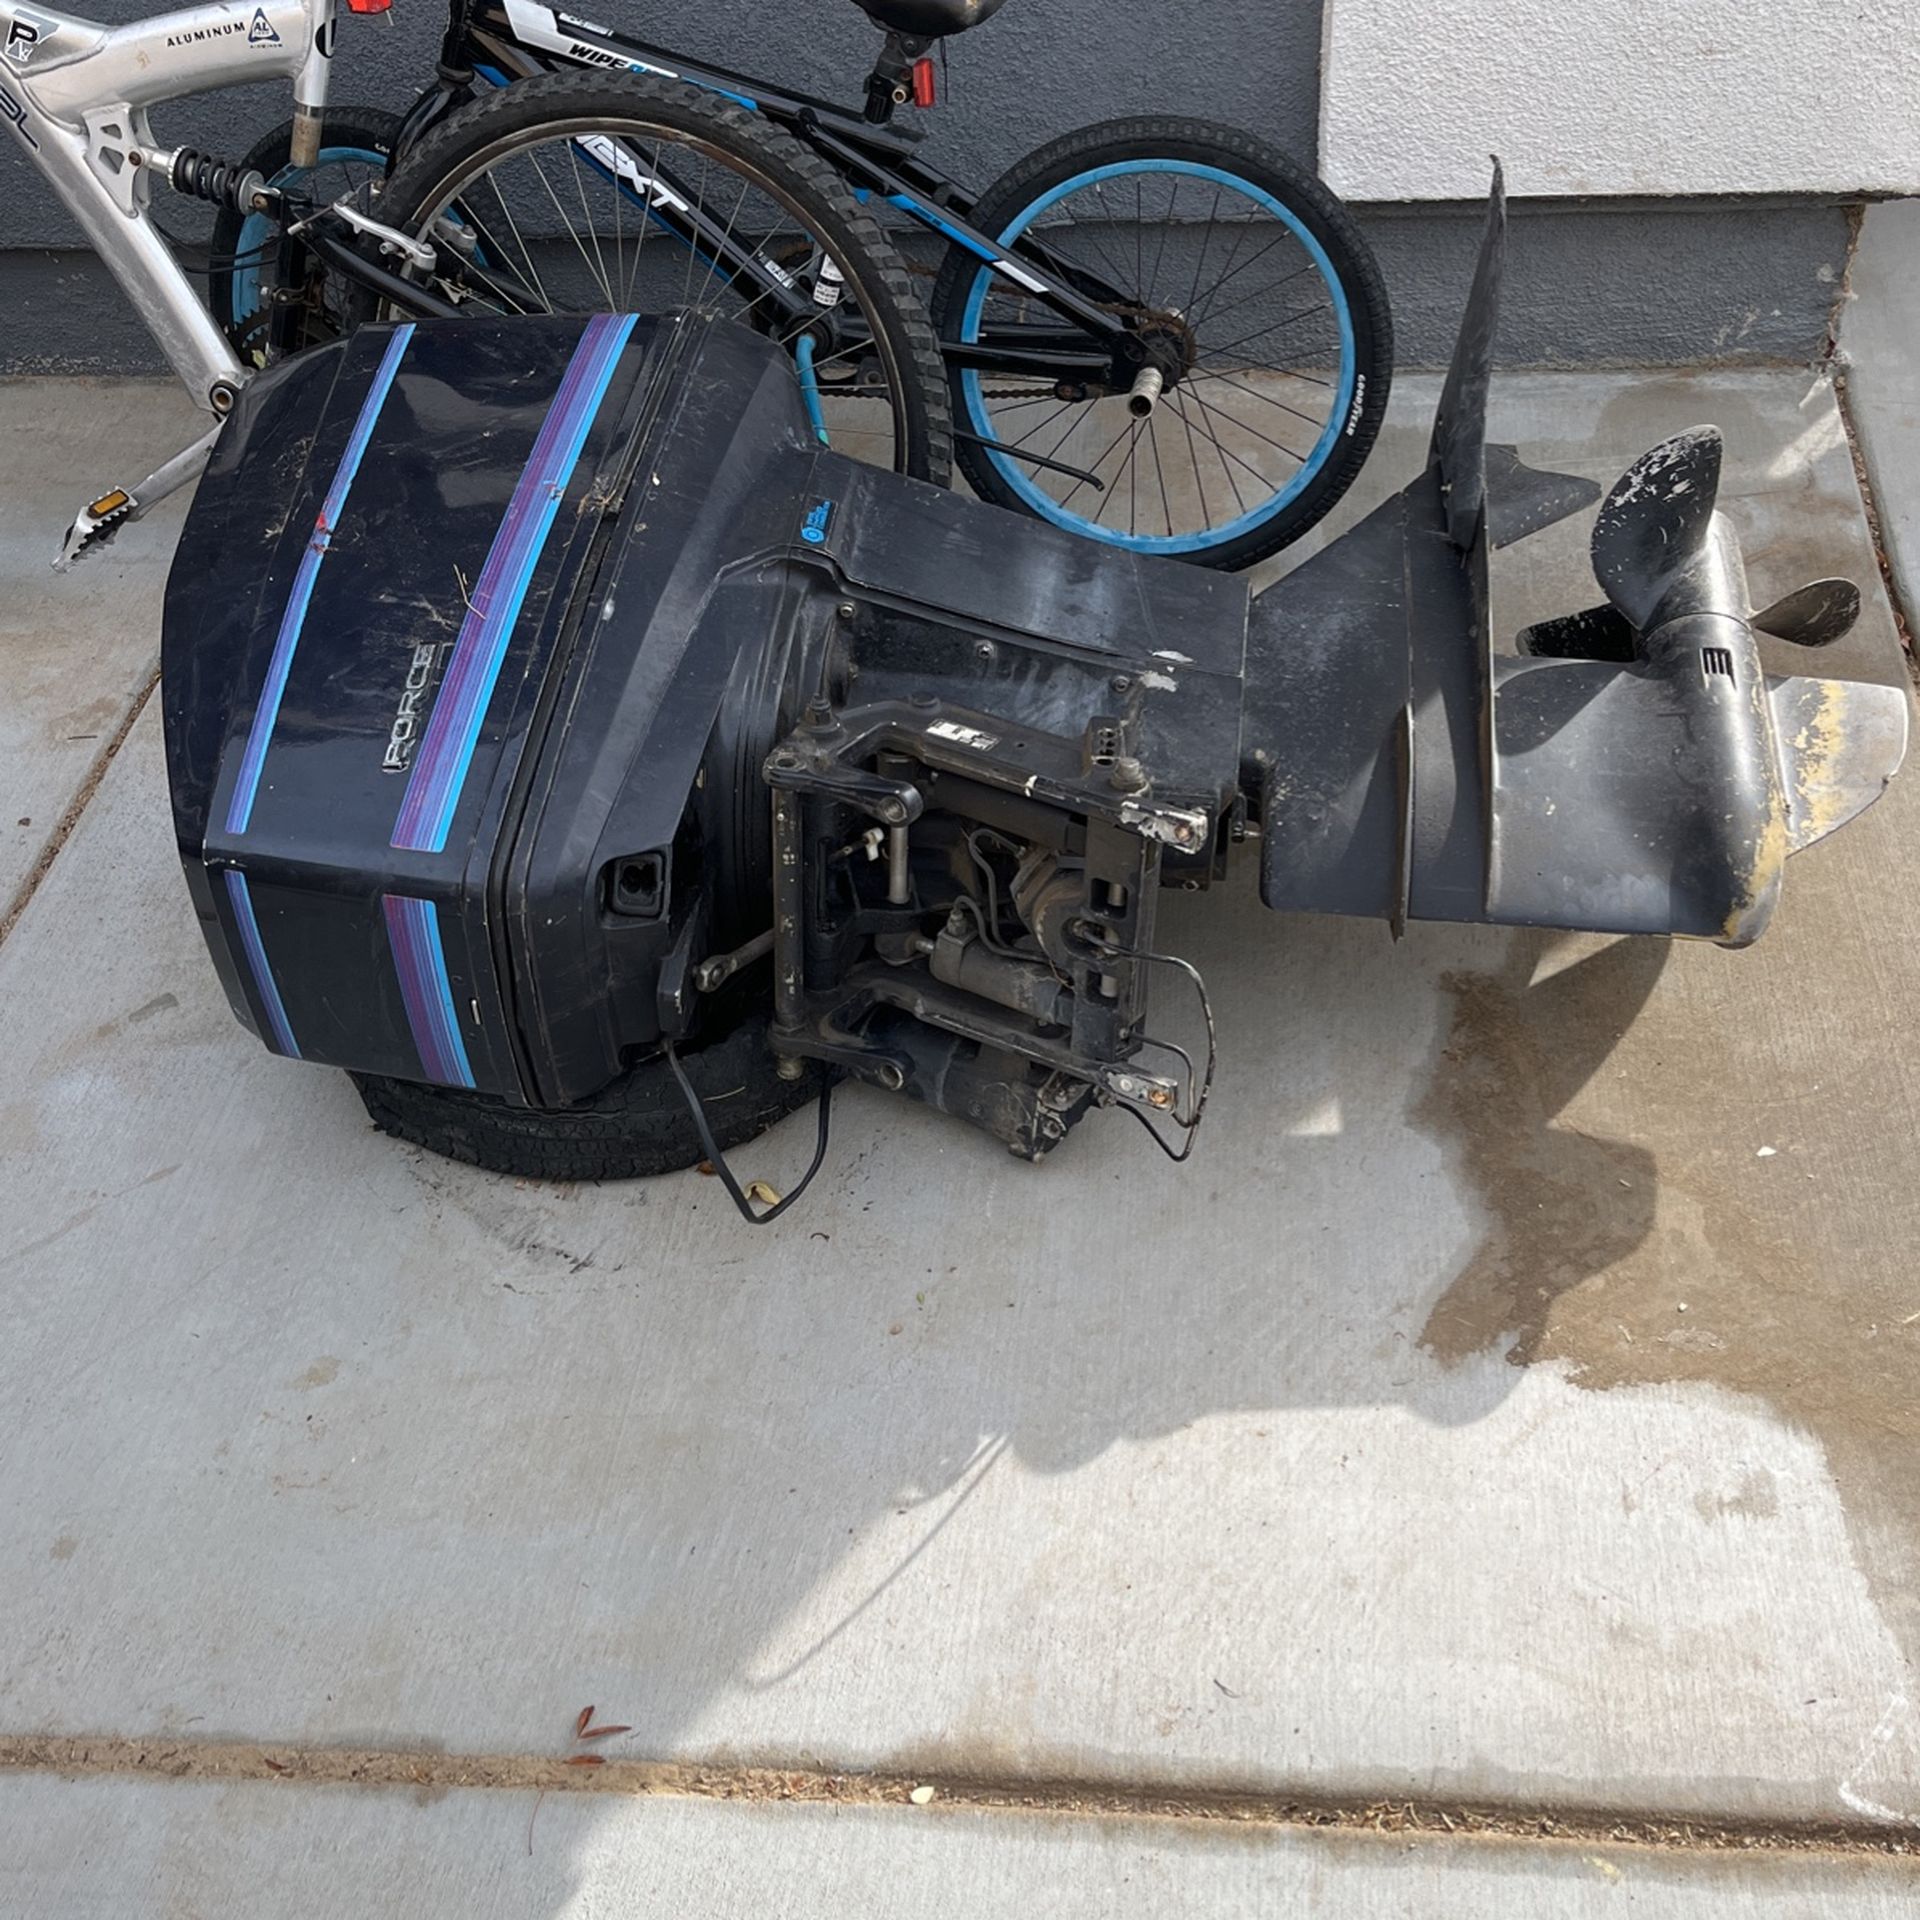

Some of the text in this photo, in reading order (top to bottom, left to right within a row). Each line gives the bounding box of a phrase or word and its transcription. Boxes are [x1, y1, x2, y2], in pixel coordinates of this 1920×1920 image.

[166, 21, 246, 47] ALUMINUM
[254, 22, 269, 32] AL
[575, 135, 689, 212] EXT
[382, 640, 436, 773] FORCE
